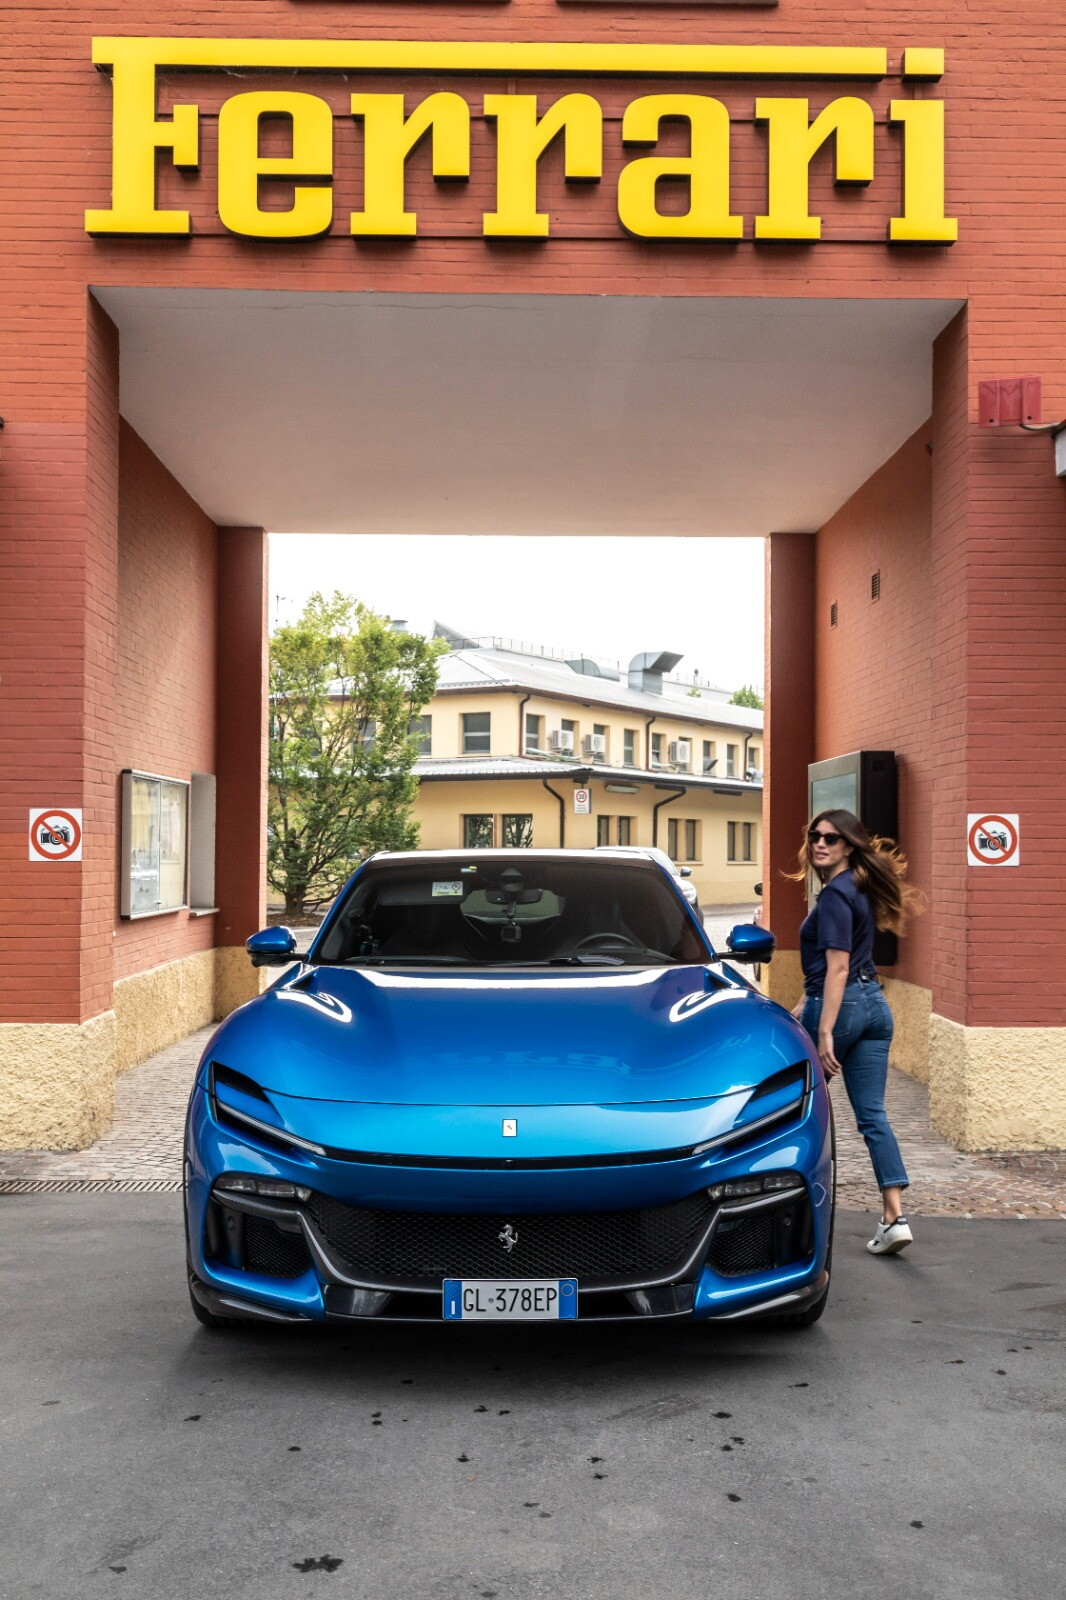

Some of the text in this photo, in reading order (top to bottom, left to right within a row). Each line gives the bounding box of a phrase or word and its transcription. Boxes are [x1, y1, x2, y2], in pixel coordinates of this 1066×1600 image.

[84, 36, 959, 242] Ferrari
[463, 1287, 558, 1312] GL 378EP
